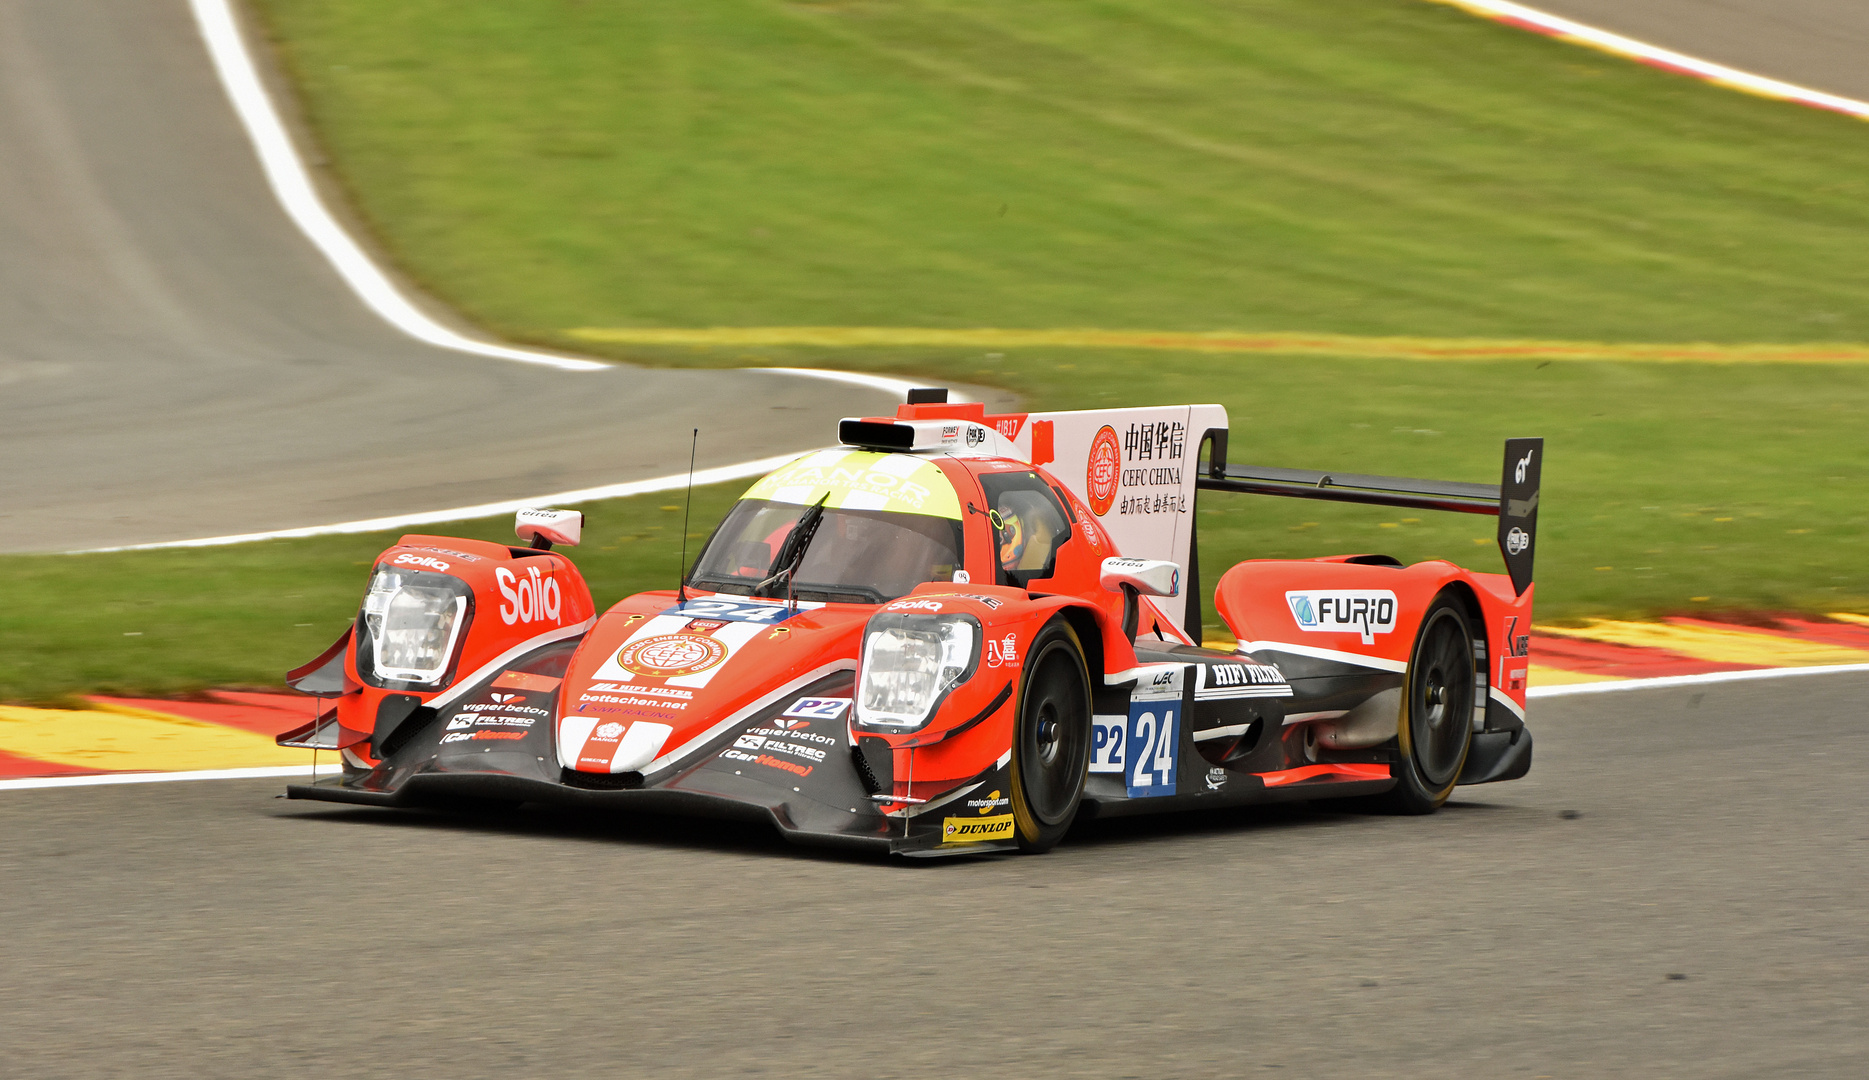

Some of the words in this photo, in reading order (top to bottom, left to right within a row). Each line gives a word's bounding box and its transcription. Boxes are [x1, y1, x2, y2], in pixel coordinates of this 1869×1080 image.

[1125, 422, 1185, 461] 中国华信
[1094, 463, 1111, 479] CEFC
[1122, 468, 1148, 487] CEFC
[1148, 467, 1181, 486] CHINA
[761, 467, 932, 502] MANOR
[787, 478, 841, 487] MANOR
[842, 479, 868, 490] TRS
[870, 485, 925, 509] RACING
[675, 601, 785, 621] 24
[646, 648, 696, 660] CEFC
[988, 633, 1017, 668] 八喜
[1153, 671, 1175, 686] WEC
[1212, 664, 1248, 685] HIFI
[619, 684, 648, 693] HIFI
[649, 687, 693, 697] FILTER
[579, 693, 689, 710] bettschen.net
[791, 700, 844, 716] P2
[476, 716, 536, 725] FILTREC
[590, 705, 622, 714] SMP
[623, 708, 677, 720] RACING
[765, 740, 827, 759] FILTREC
[1090, 724, 1123, 764] P2
[1133, 710, 1174, 787] 24
[967, 797, 1009, 809] motorsport.com
[958, 821, 1012, 834] DUNLOP
